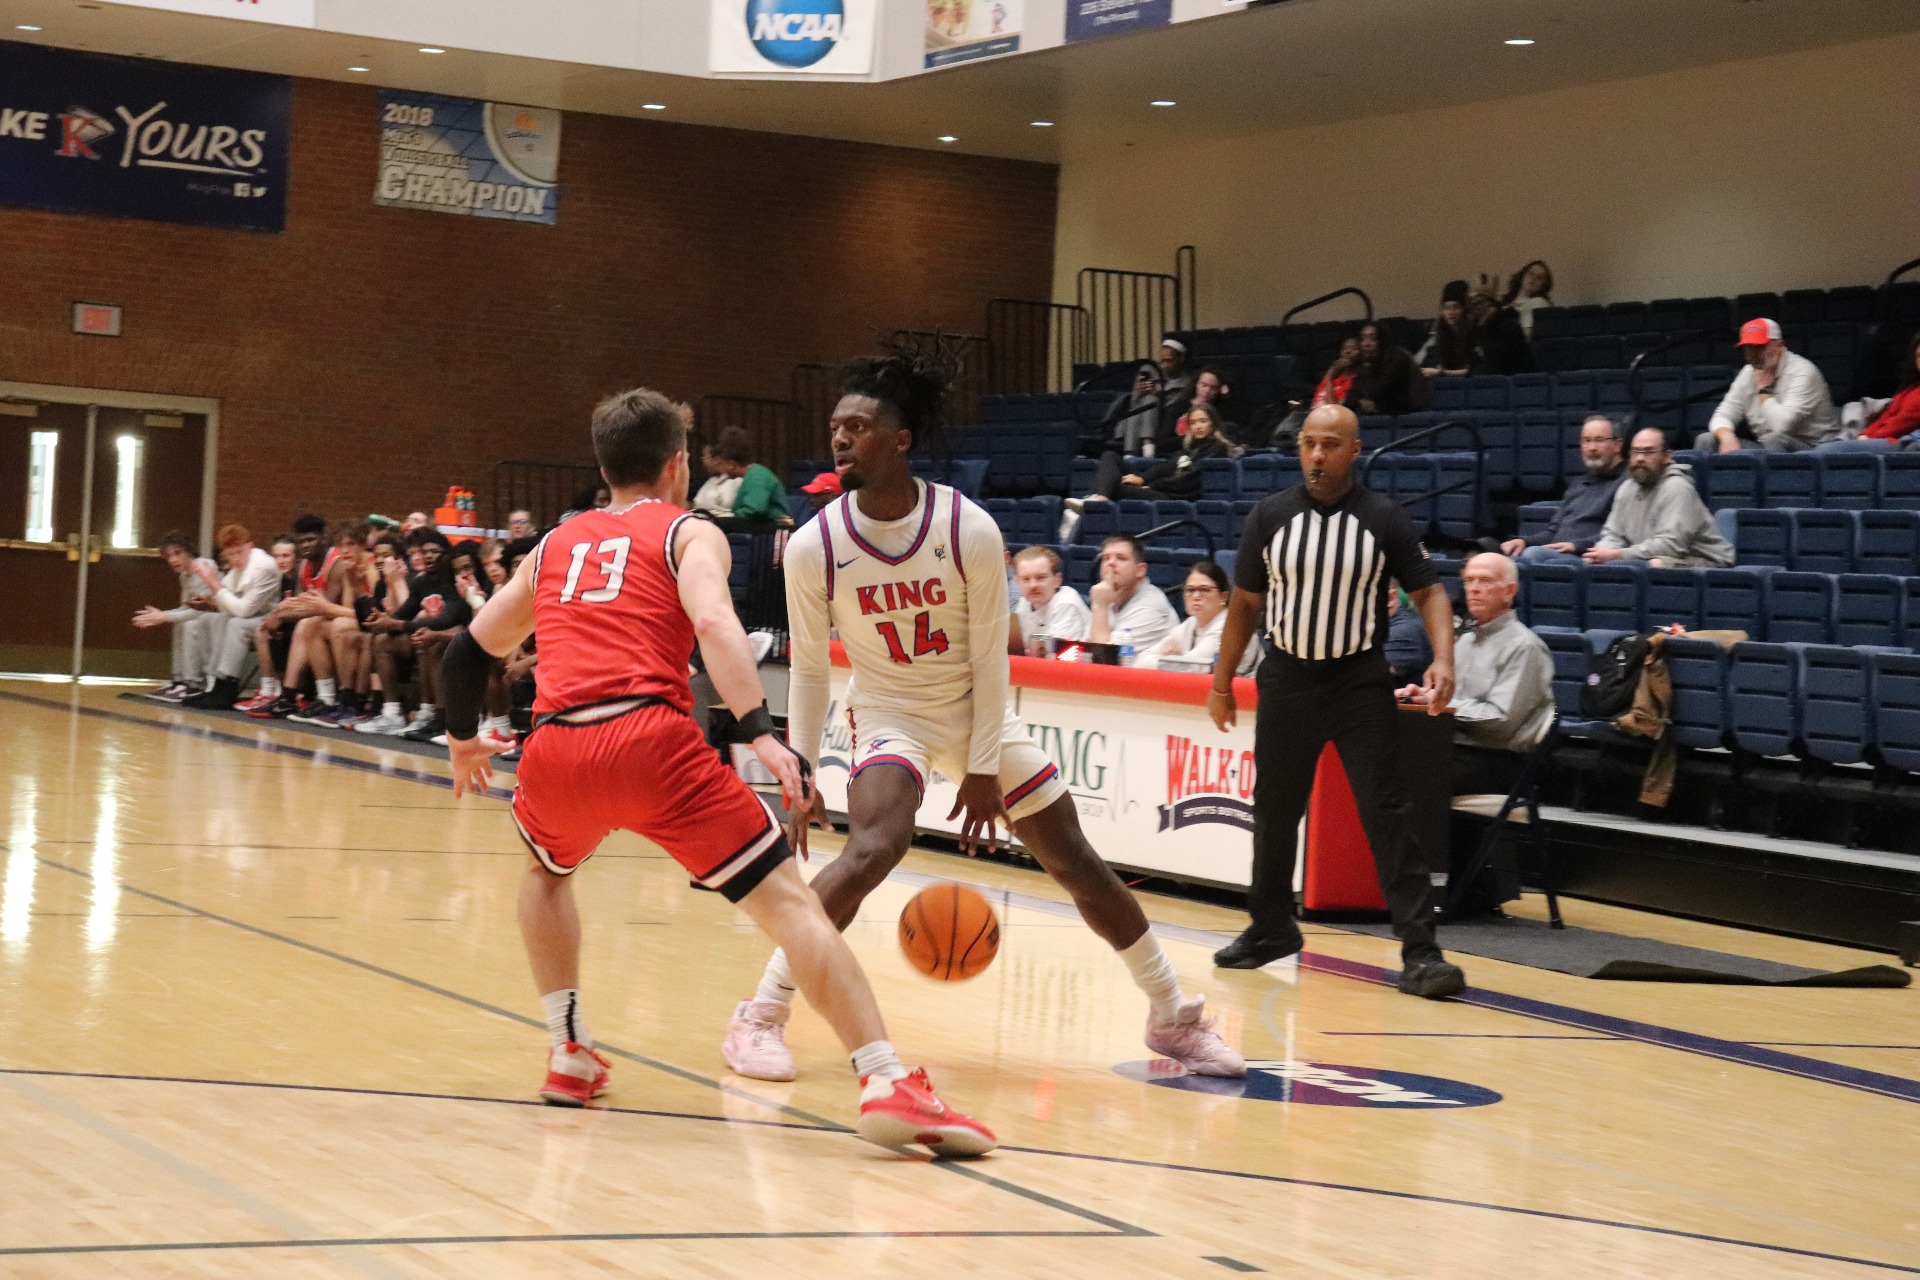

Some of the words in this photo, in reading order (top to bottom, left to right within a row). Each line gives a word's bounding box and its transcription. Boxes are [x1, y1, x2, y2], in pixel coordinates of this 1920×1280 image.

[752, 13, 841, 42] NCAA
[382, 103, 435, 127] 2018
[380, 165, 549, 216] CHAMPION
[559, 535, 632, 604] 13
[856, 578, 947, 616] KING
[875, 610, 950, 664] 14
